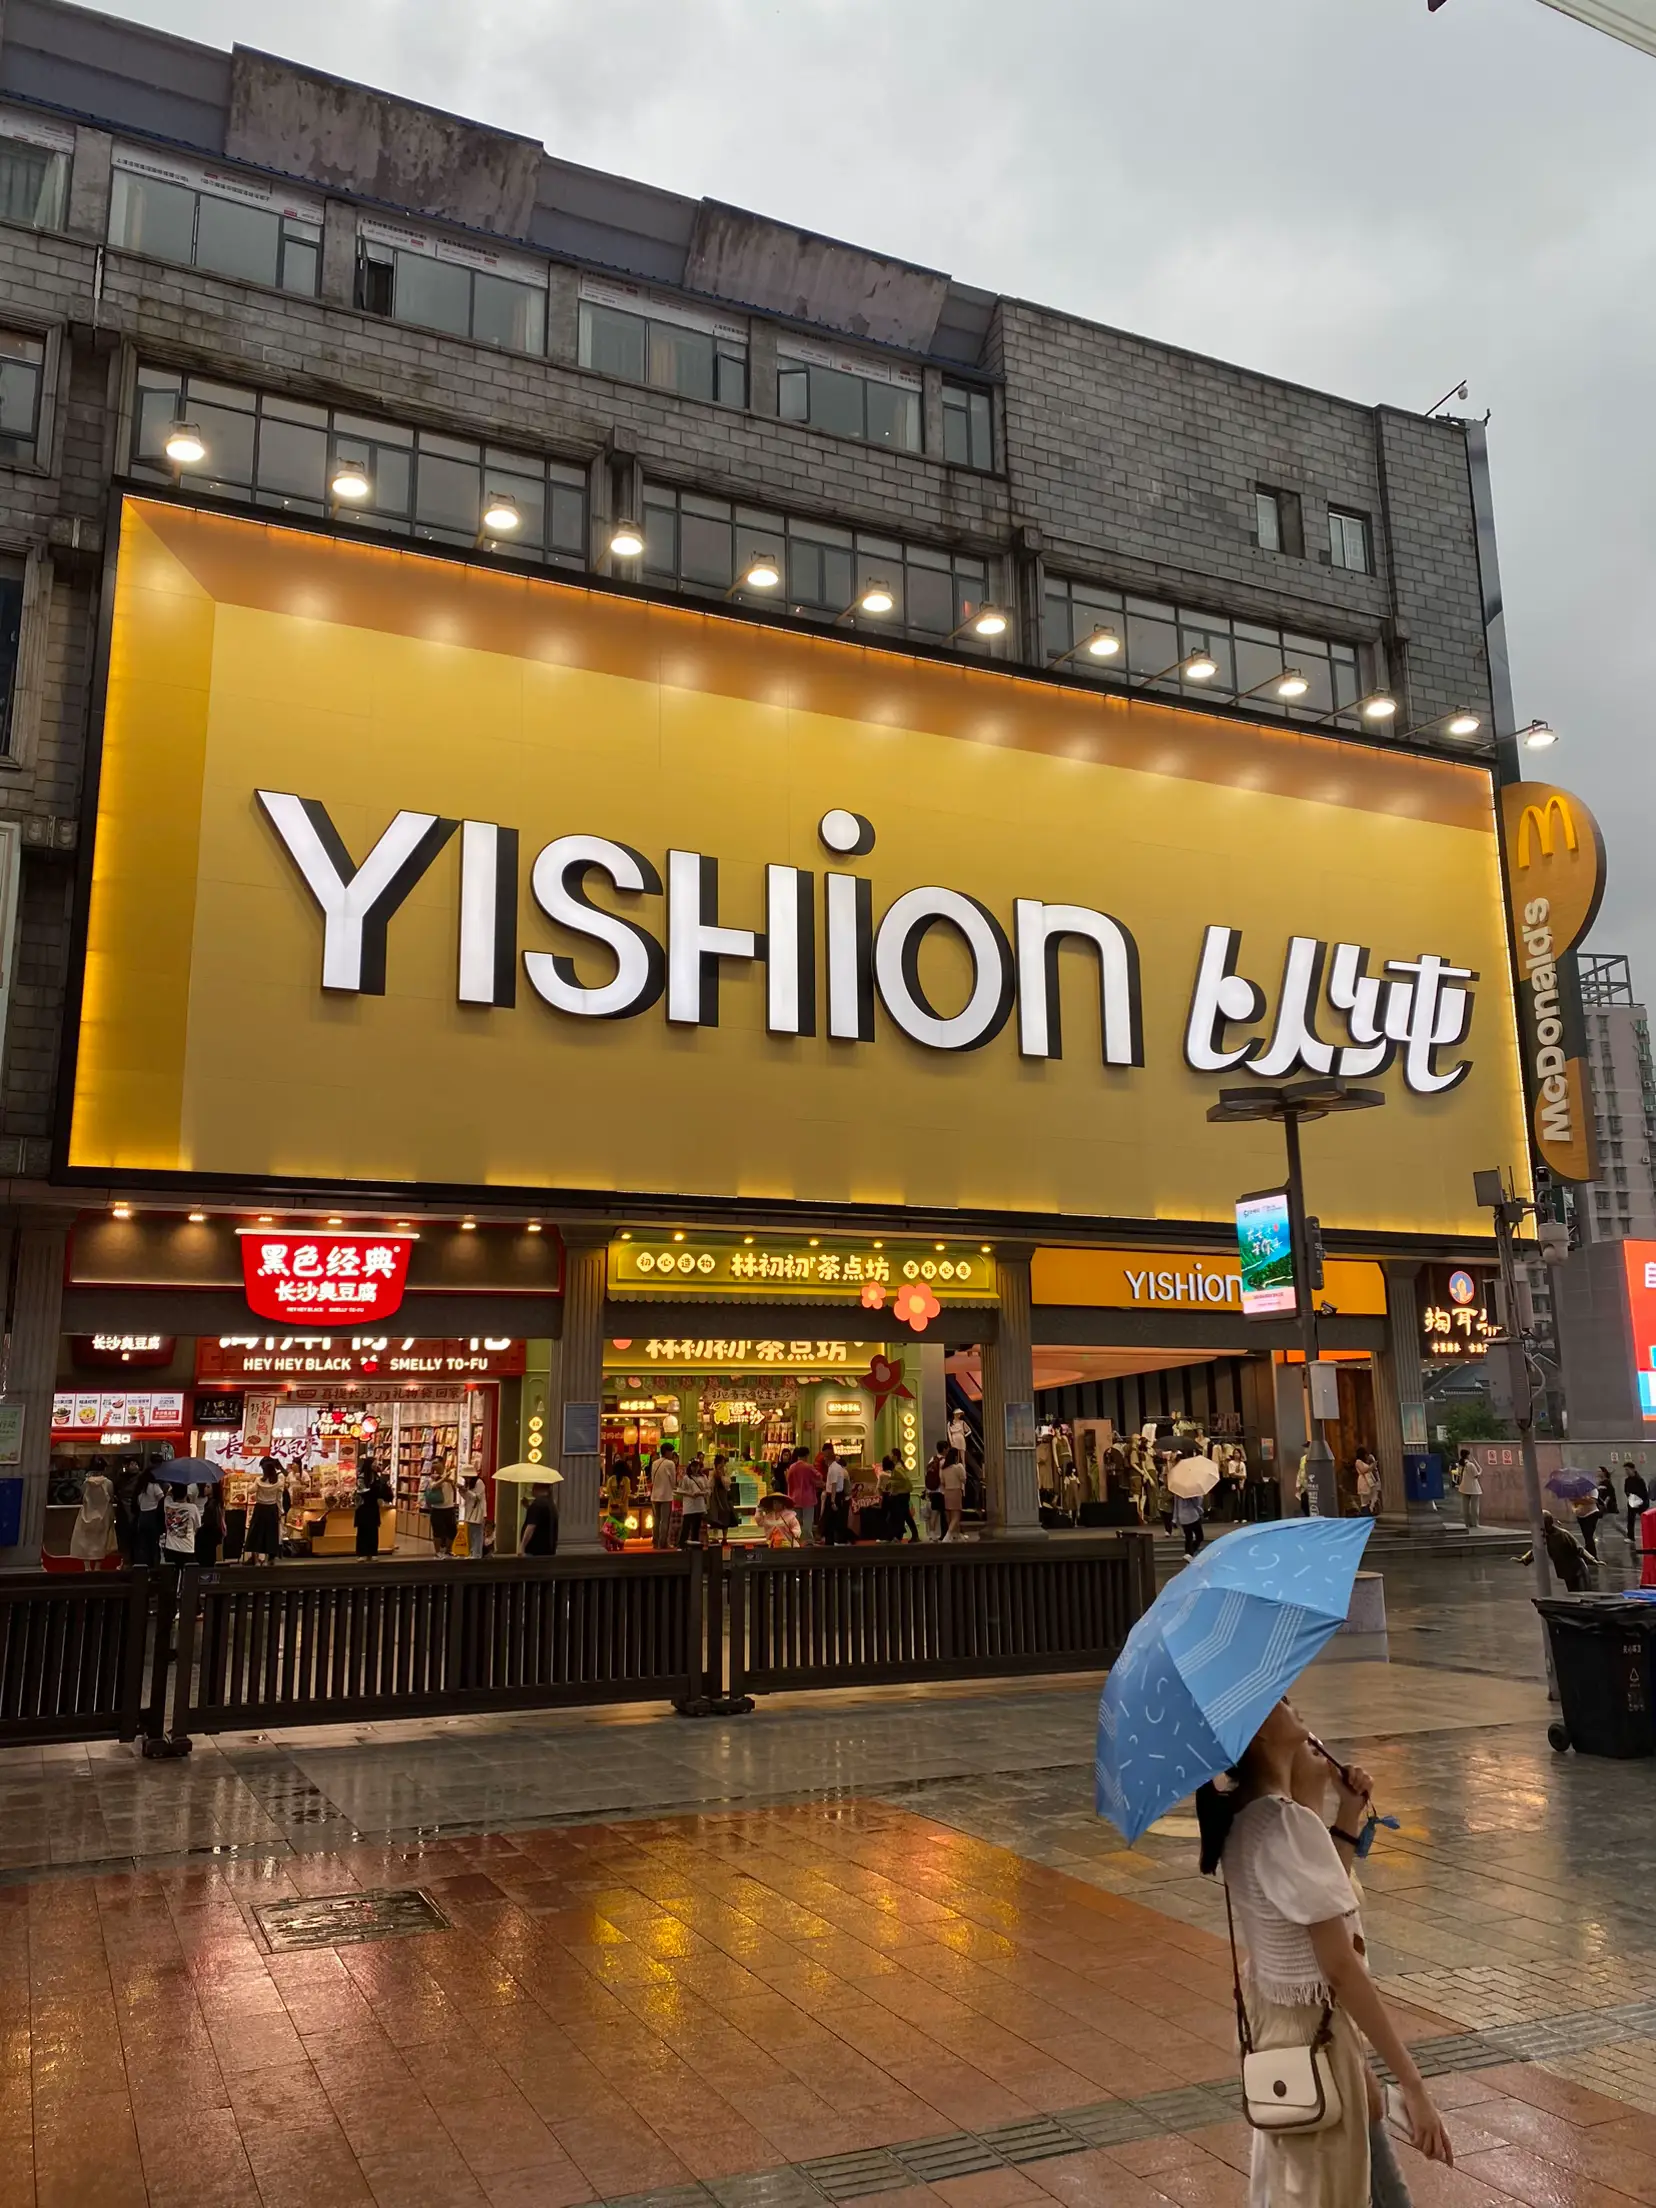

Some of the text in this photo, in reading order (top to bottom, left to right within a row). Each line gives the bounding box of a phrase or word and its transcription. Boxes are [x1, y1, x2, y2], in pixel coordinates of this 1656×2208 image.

[1523, 897, 1573, 1143] McDonald's
[257, 1244, 397, 1279] 黑色经典
[275, 1280, 379, 1303] 长沙臭豆腐
[92, 1335, 161, 1350] 长沙臭豆腐
[243, 1358, 488, 1371] HEY HEY BLACK SMELLY TO-FU
